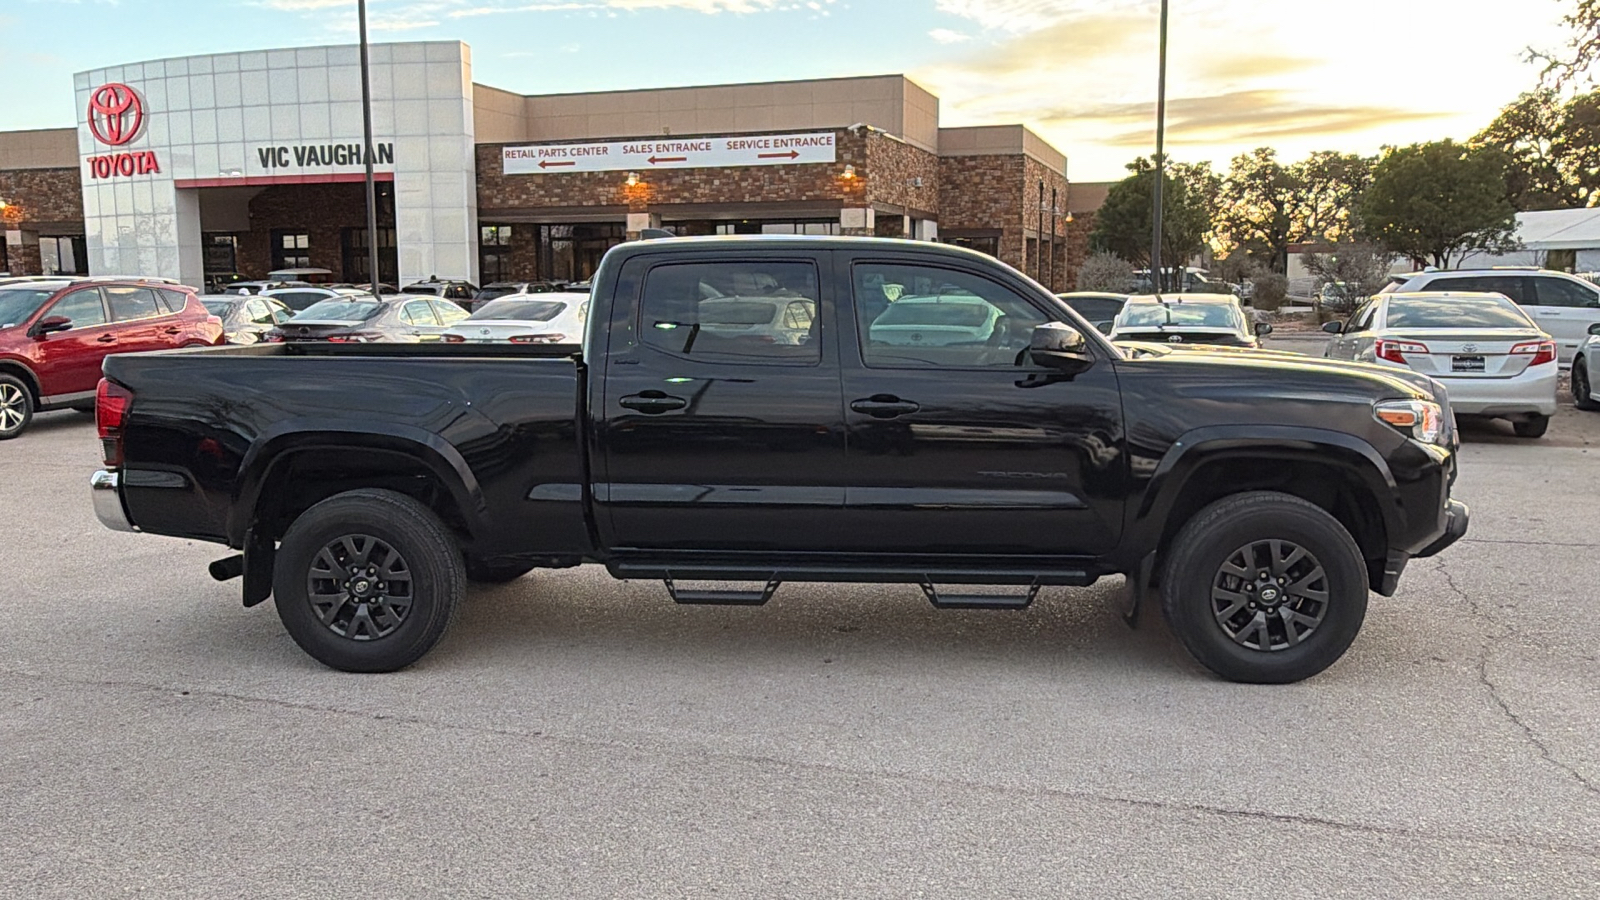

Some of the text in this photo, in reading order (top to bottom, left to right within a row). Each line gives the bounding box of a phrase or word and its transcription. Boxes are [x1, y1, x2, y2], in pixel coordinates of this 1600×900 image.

[622, 141, 712, 154] SALES ENTRANCE
[726, 136, 833, 150] SERVICE ENTRANCE
[258, 146, 289, 168] VIC
[505, 146, 609, 159] RETAIL PARTS CENTER
[86, 151, 160, 179] TOYOTA
